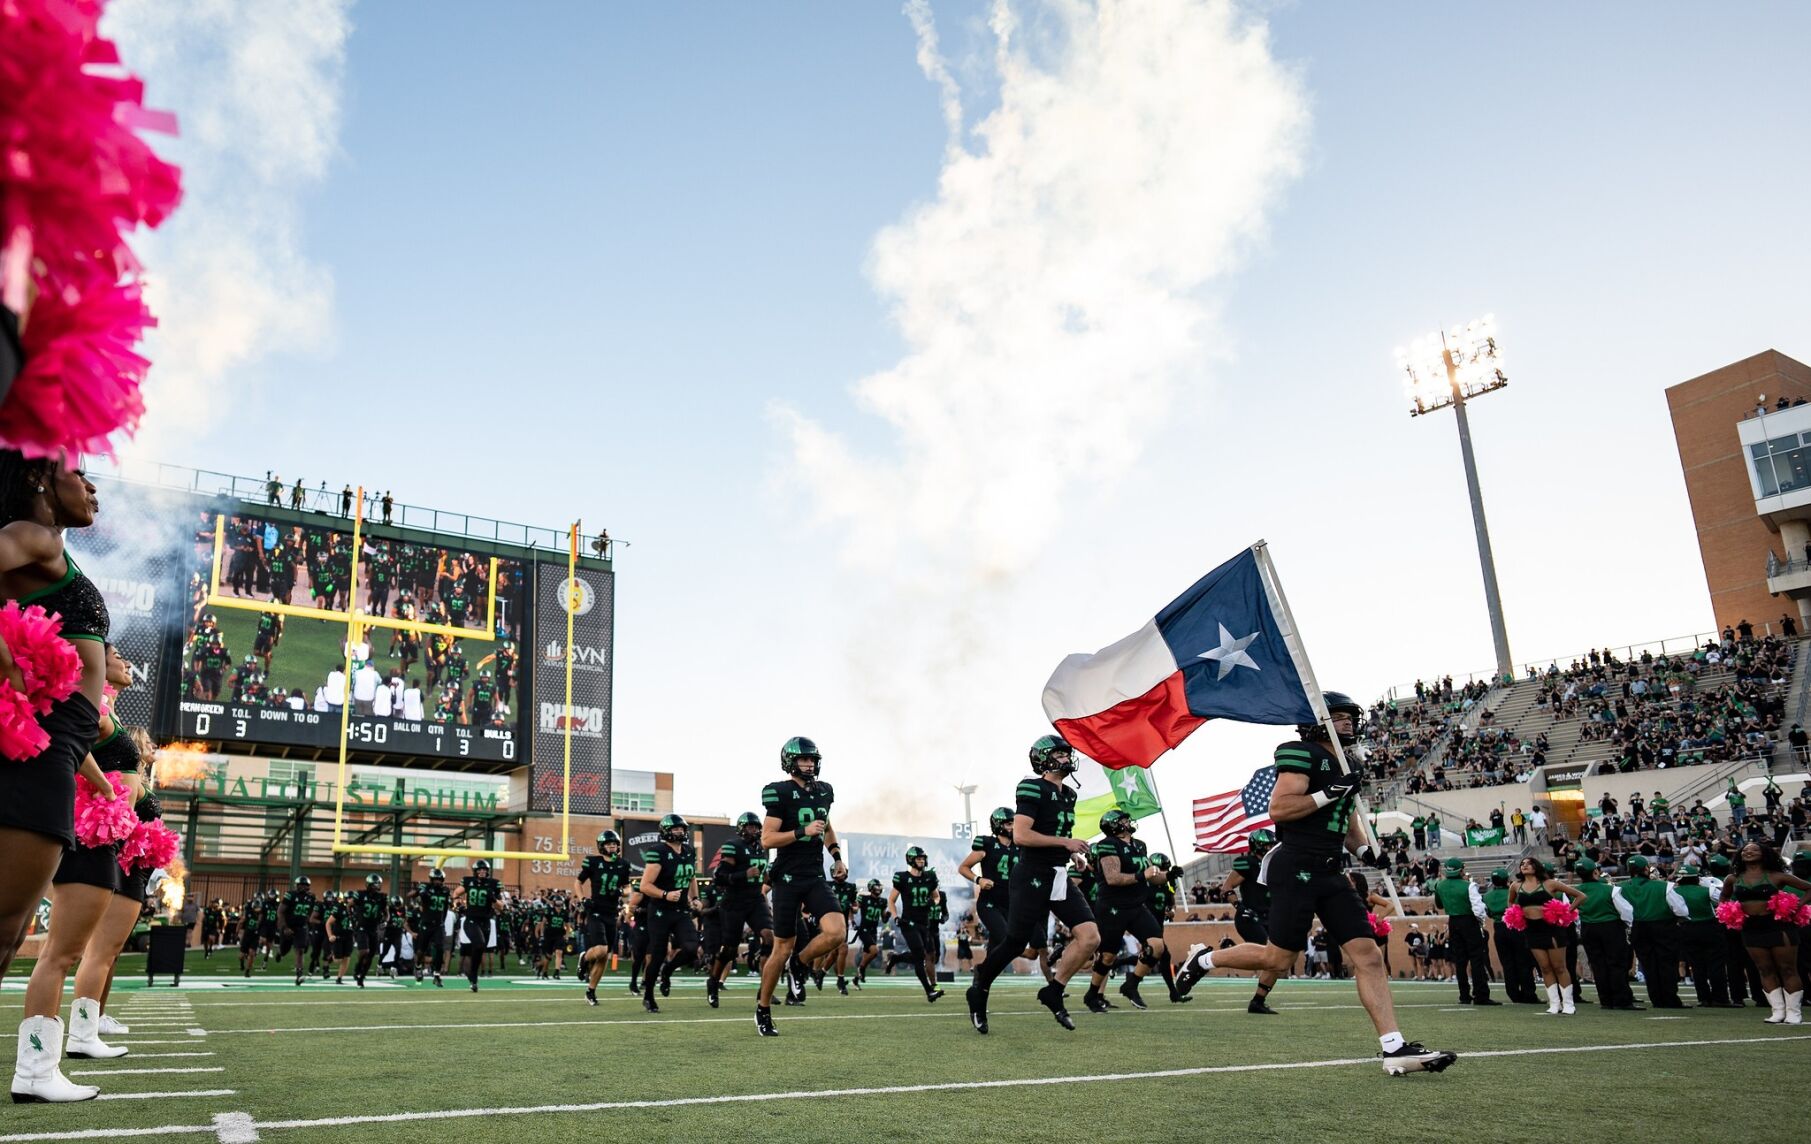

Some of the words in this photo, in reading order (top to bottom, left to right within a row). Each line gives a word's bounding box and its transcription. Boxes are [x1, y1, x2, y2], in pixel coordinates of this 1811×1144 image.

[231, 708, 252, 719] T.O.L.
[260, 709, 288, 722] DOWN
[293, 713, 306, 723] TO
[306, 714, 320, 724] GO
[540, 702, 605, 732] RHINO
[195, 713, 211, 736] 0
[235, 719, 247, 738] 3
[393, 722, 410, 732] BALL
[410, 723, 421, 733] ON
[427, 724, 445, 736] QTR
[456, 728, 473, 739] T.O.L.
[483, 728, 513, 741] BULLS
[435, 737, 441, 752] 1
[459, 738, 470, 756] 3
[502, 740, 515, 760] 0
[346, 782, 498, 812] STADIUM
[954, 823, 972, 840] 25
[533, 836, 553, 852] 75
[557, 837, 576, 846] JE
[628, 833, 659, 847] GREEN
[557, 844, 594, 855] GEENE
[862, 840, 900, 857] Kwik
[531, 860, 552, 874] 33
[557, 867, 580, 877] RENF
[868, 860, 897, 877] Kar
[468, 888, 487, 906] 86
